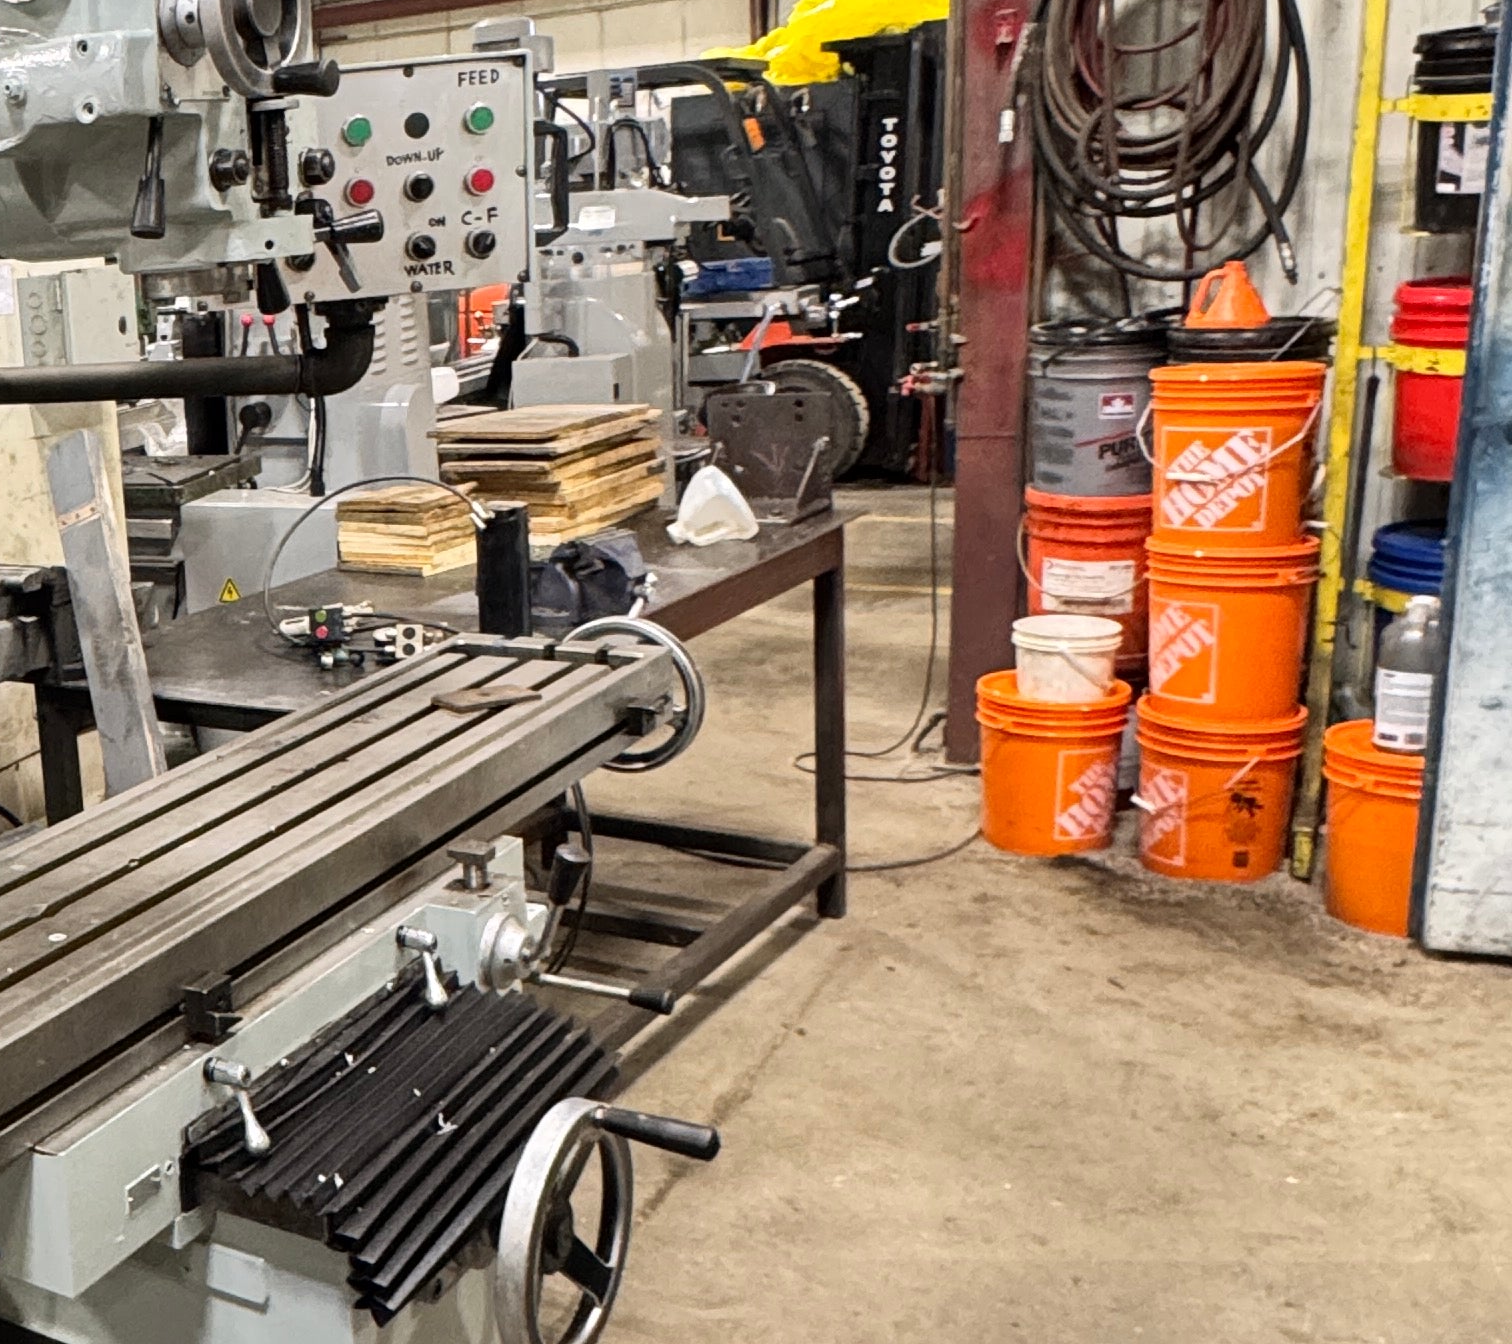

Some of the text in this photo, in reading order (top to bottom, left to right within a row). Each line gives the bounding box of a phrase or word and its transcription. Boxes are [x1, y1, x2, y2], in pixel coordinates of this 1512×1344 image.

[457, 68, 500, 88] FEED
[876, 117, 899, 213] TOYOTA
[461, 207, 499, 226] C-F
[404, 260, 456, 277] WATER
[1098, 436, 1140, 460] PUR
[1166, 439, 1213, 475] THE
[1160, 429, 1270, 527] HOME
[1193, 467, 1267, 528] DEPOT
